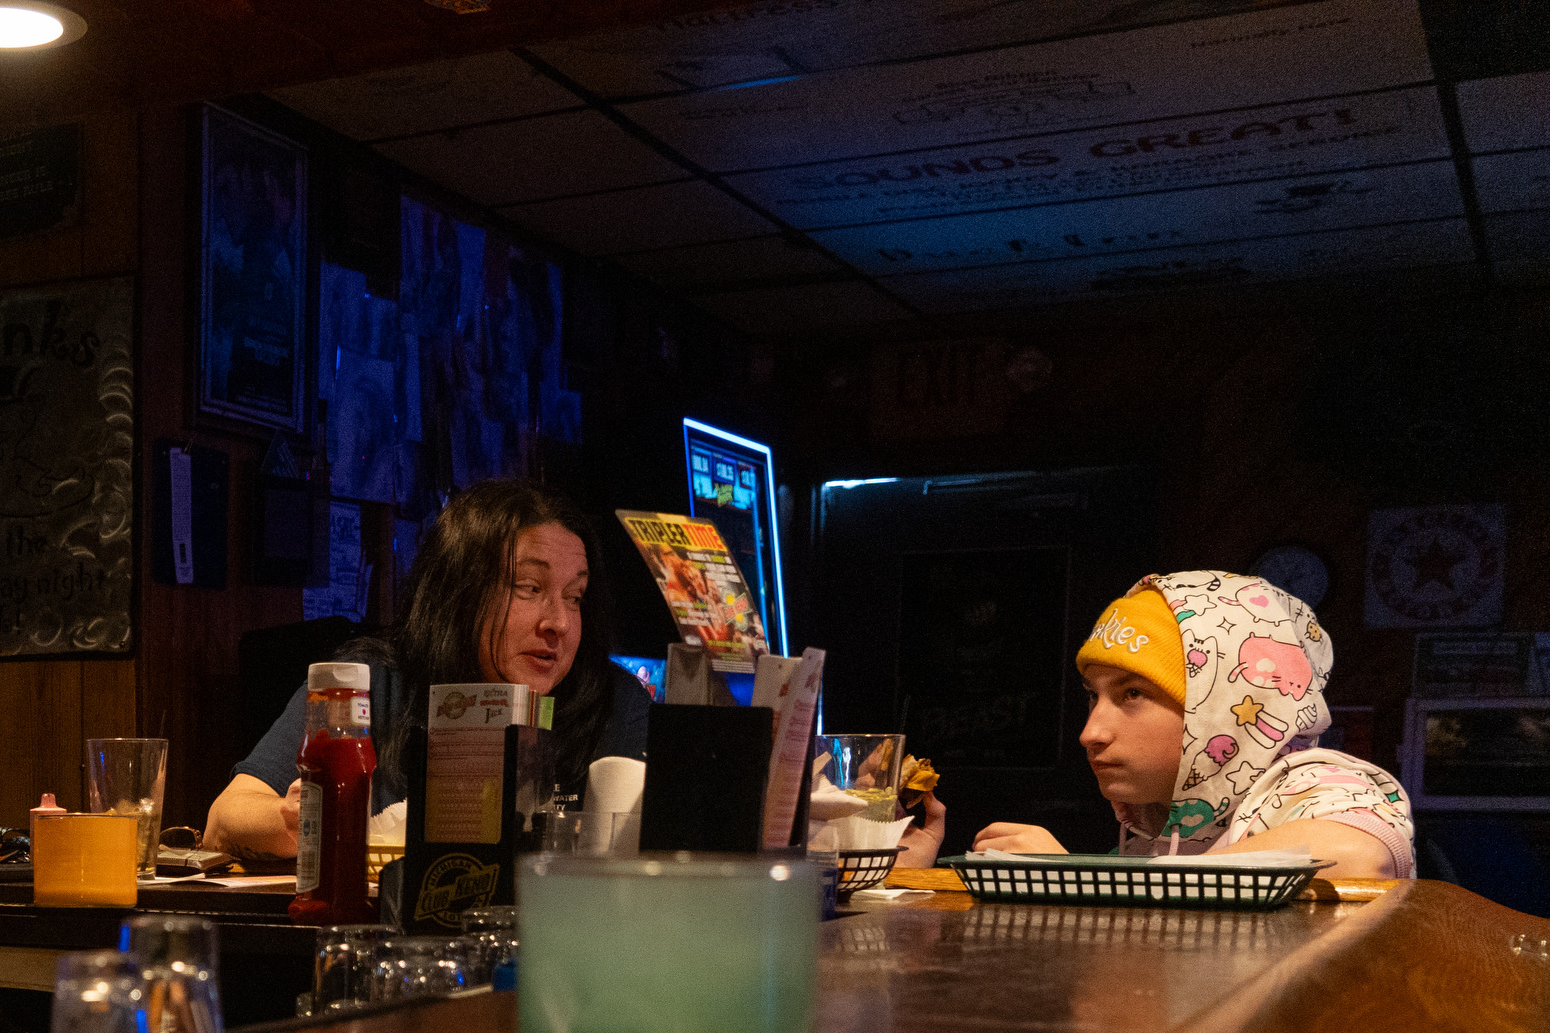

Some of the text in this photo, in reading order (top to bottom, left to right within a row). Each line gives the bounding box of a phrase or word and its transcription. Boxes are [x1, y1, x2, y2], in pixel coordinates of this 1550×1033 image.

[792, 106, 1358, 190] SOUNDS GREAT!
[6, 525, 48, 558] the
[627, 519, 725, 550] TRIPLER TIME
[35, 560, 107, 604] night
[429, 859, 472, 887] MICHIGAN
[421, 890, 450, 913] CLUB
[455, 873, 491, 898] KENO
